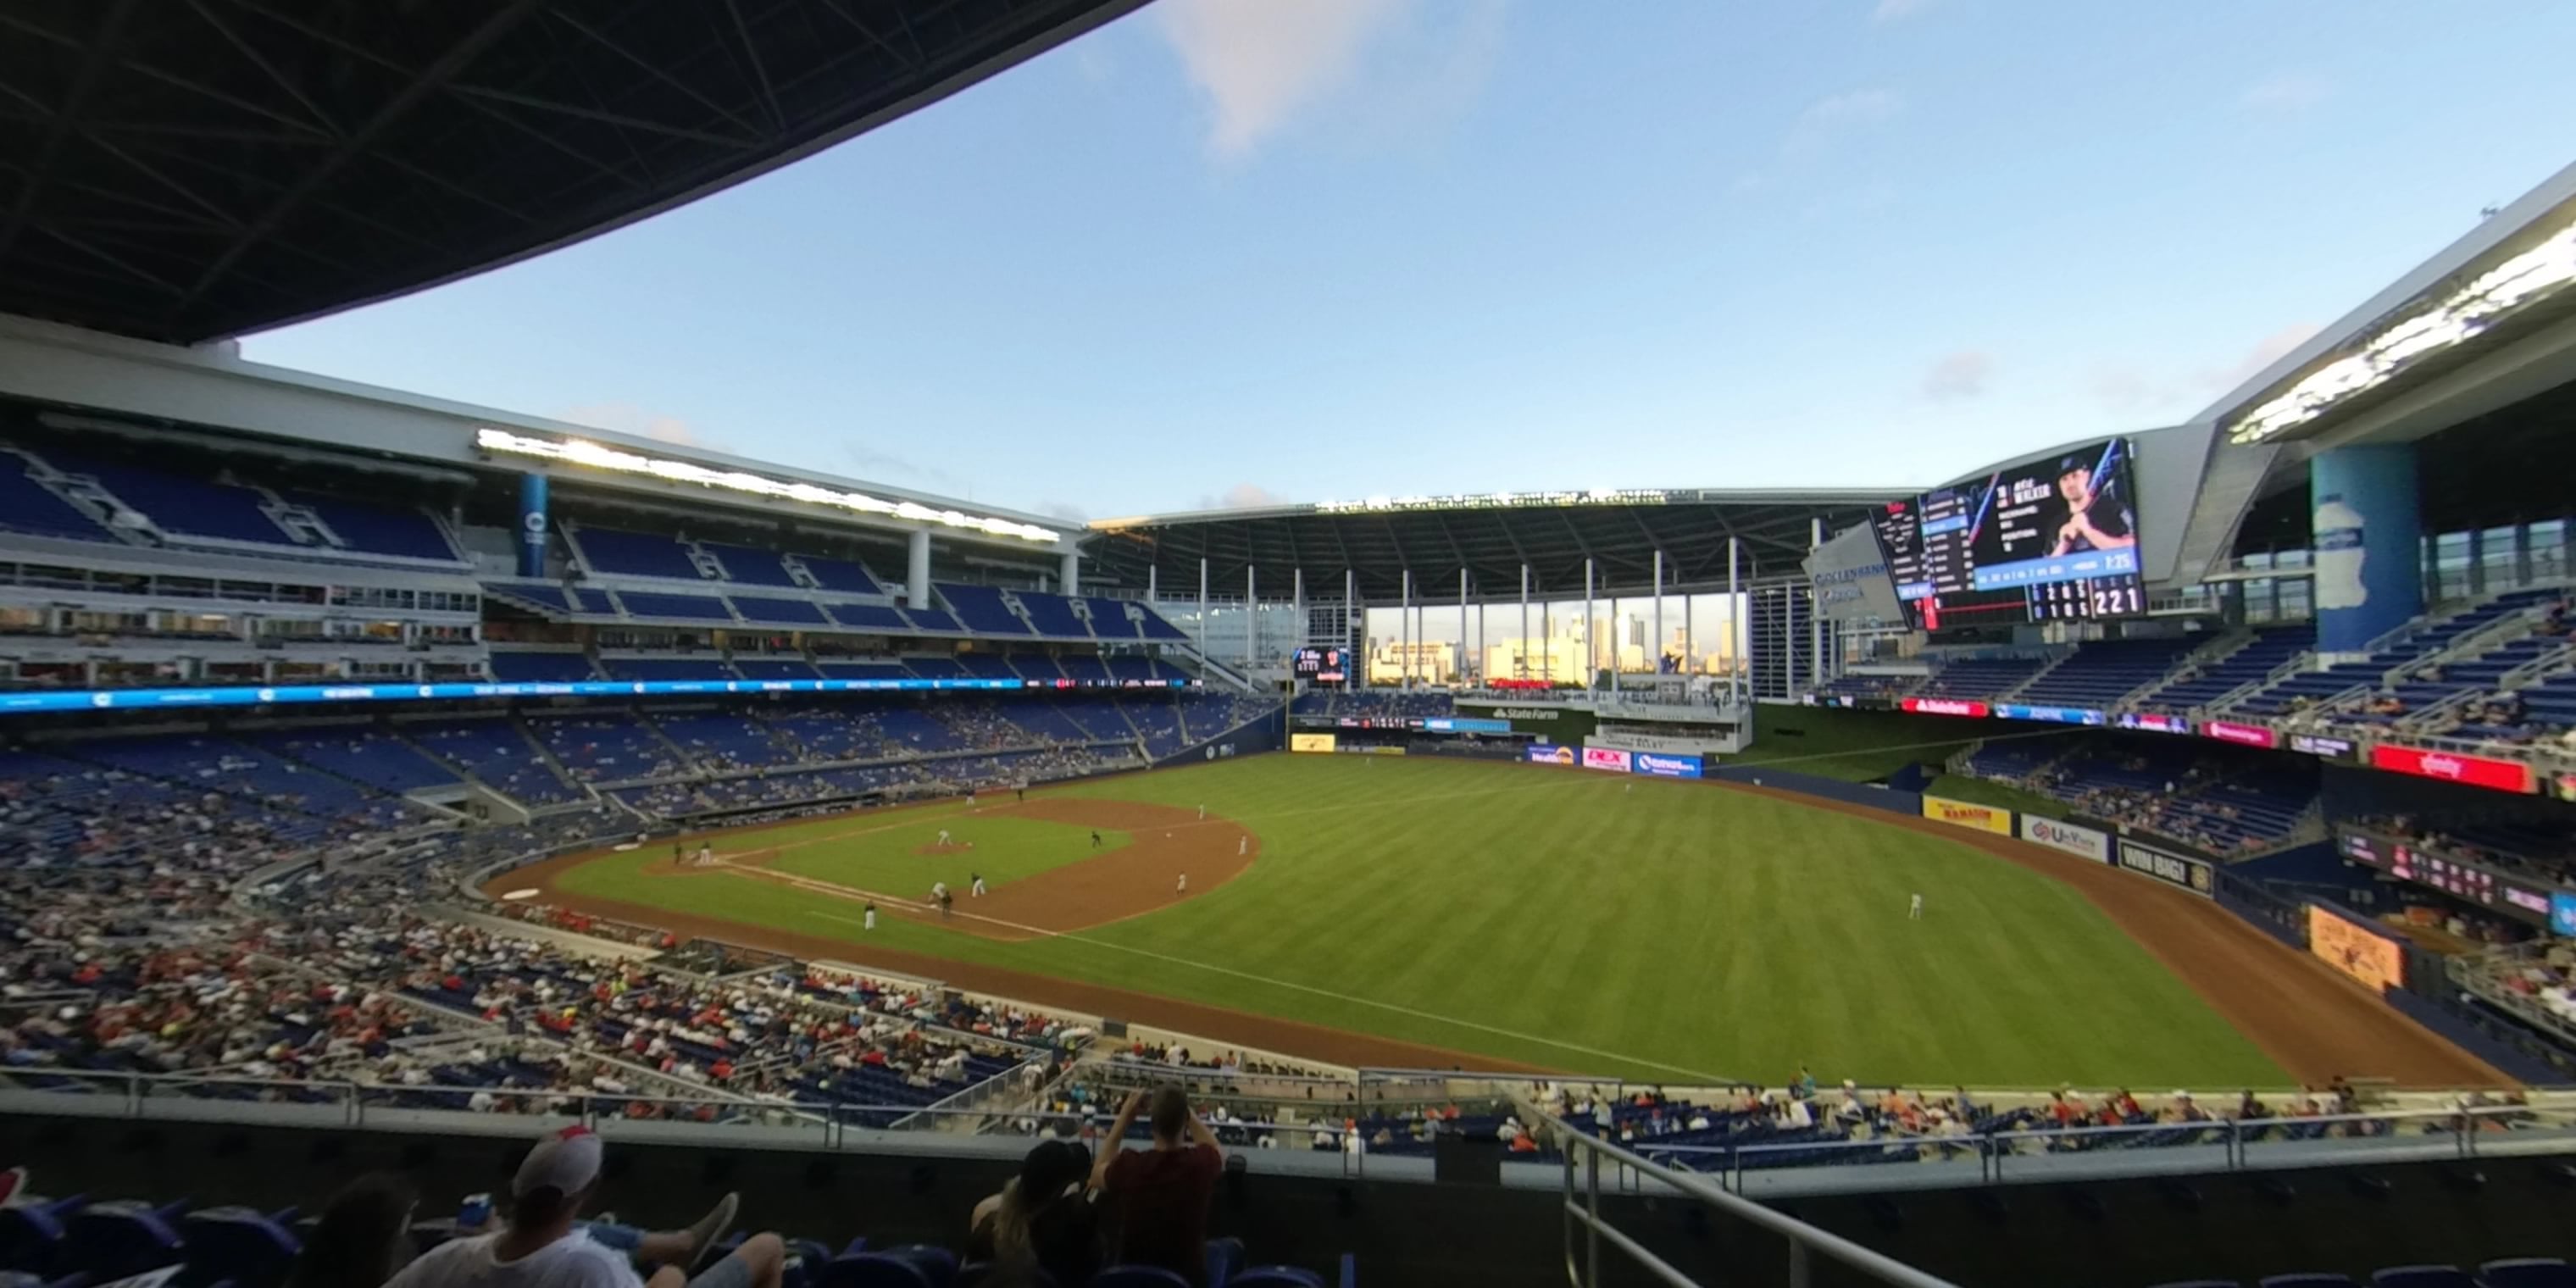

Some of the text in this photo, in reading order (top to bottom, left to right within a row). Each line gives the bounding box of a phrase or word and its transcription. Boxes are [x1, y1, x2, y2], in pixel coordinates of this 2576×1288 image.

[2095, 588, 2138, 614] 2 2 1
[2123, 845, 2185, 884] WIN BIG!
